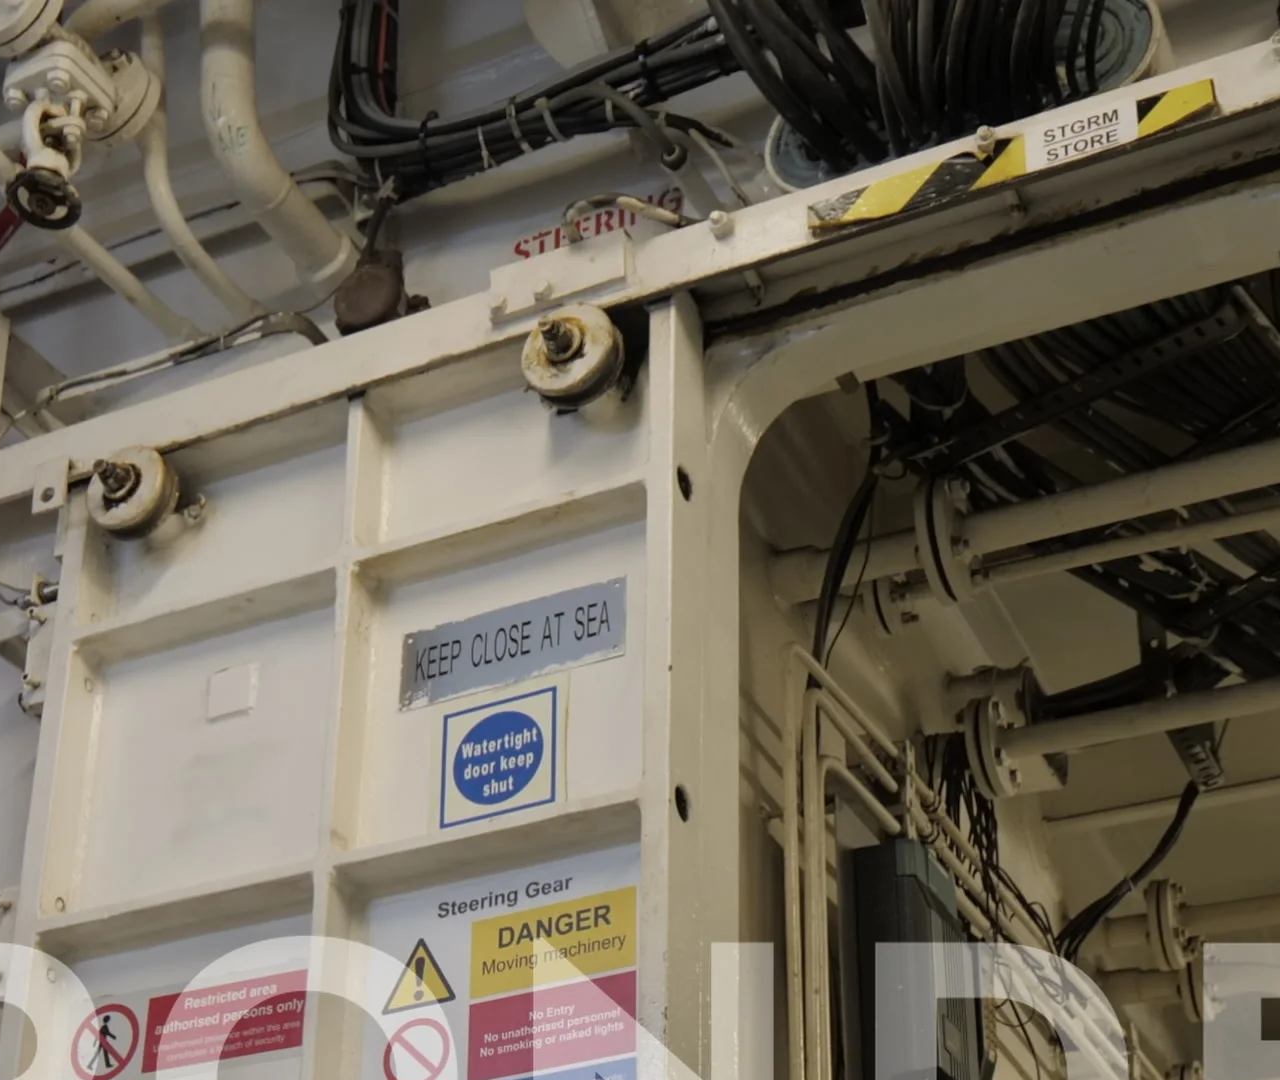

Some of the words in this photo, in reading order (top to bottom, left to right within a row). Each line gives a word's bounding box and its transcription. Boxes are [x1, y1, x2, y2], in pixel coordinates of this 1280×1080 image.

[1046, 129, 1119, 161] STORE
[414, 640, 462, 683] KEEP
[471, 620, 531, 667] CLOSE
[541, 612, 565, 650] AT
[574, 600, 610, 641] SEA
[461, 727, 538, 759] Watertight
[464, 762, 496, 780] door
[500, 751, 534, 772] keep
[483, 776, 514, 797] shut
[437, 888, 518, 918] Steering
[525, 876, 573, 899] Gear
[498, 905, 611, 949] DANGER
[482, 951, 538, 976] Moving
[543, 934, 626, 962] machinery
[184, 988, 246, 1010] Restricted
[250, 984, 277, 998] area
[529, 1011, 543, 1020] No
[547, 1005, 575, 1019] Entry
[155, 1014, 220, 1035] authorised
[222, 1004, 273, 1026] persons
[277, 999, 304, 1013] only
[484, 1033, 499, 1044] No
[567, 1008, 621, 1027] personnel
[480, 1047, 494, 1058] No
[497, 1038, 542, 1054] smoking
[545, 1034, 556, 1045] or
[560, 1027, 592, 1042] naked
[595, 1021, 624, 1036] lights
